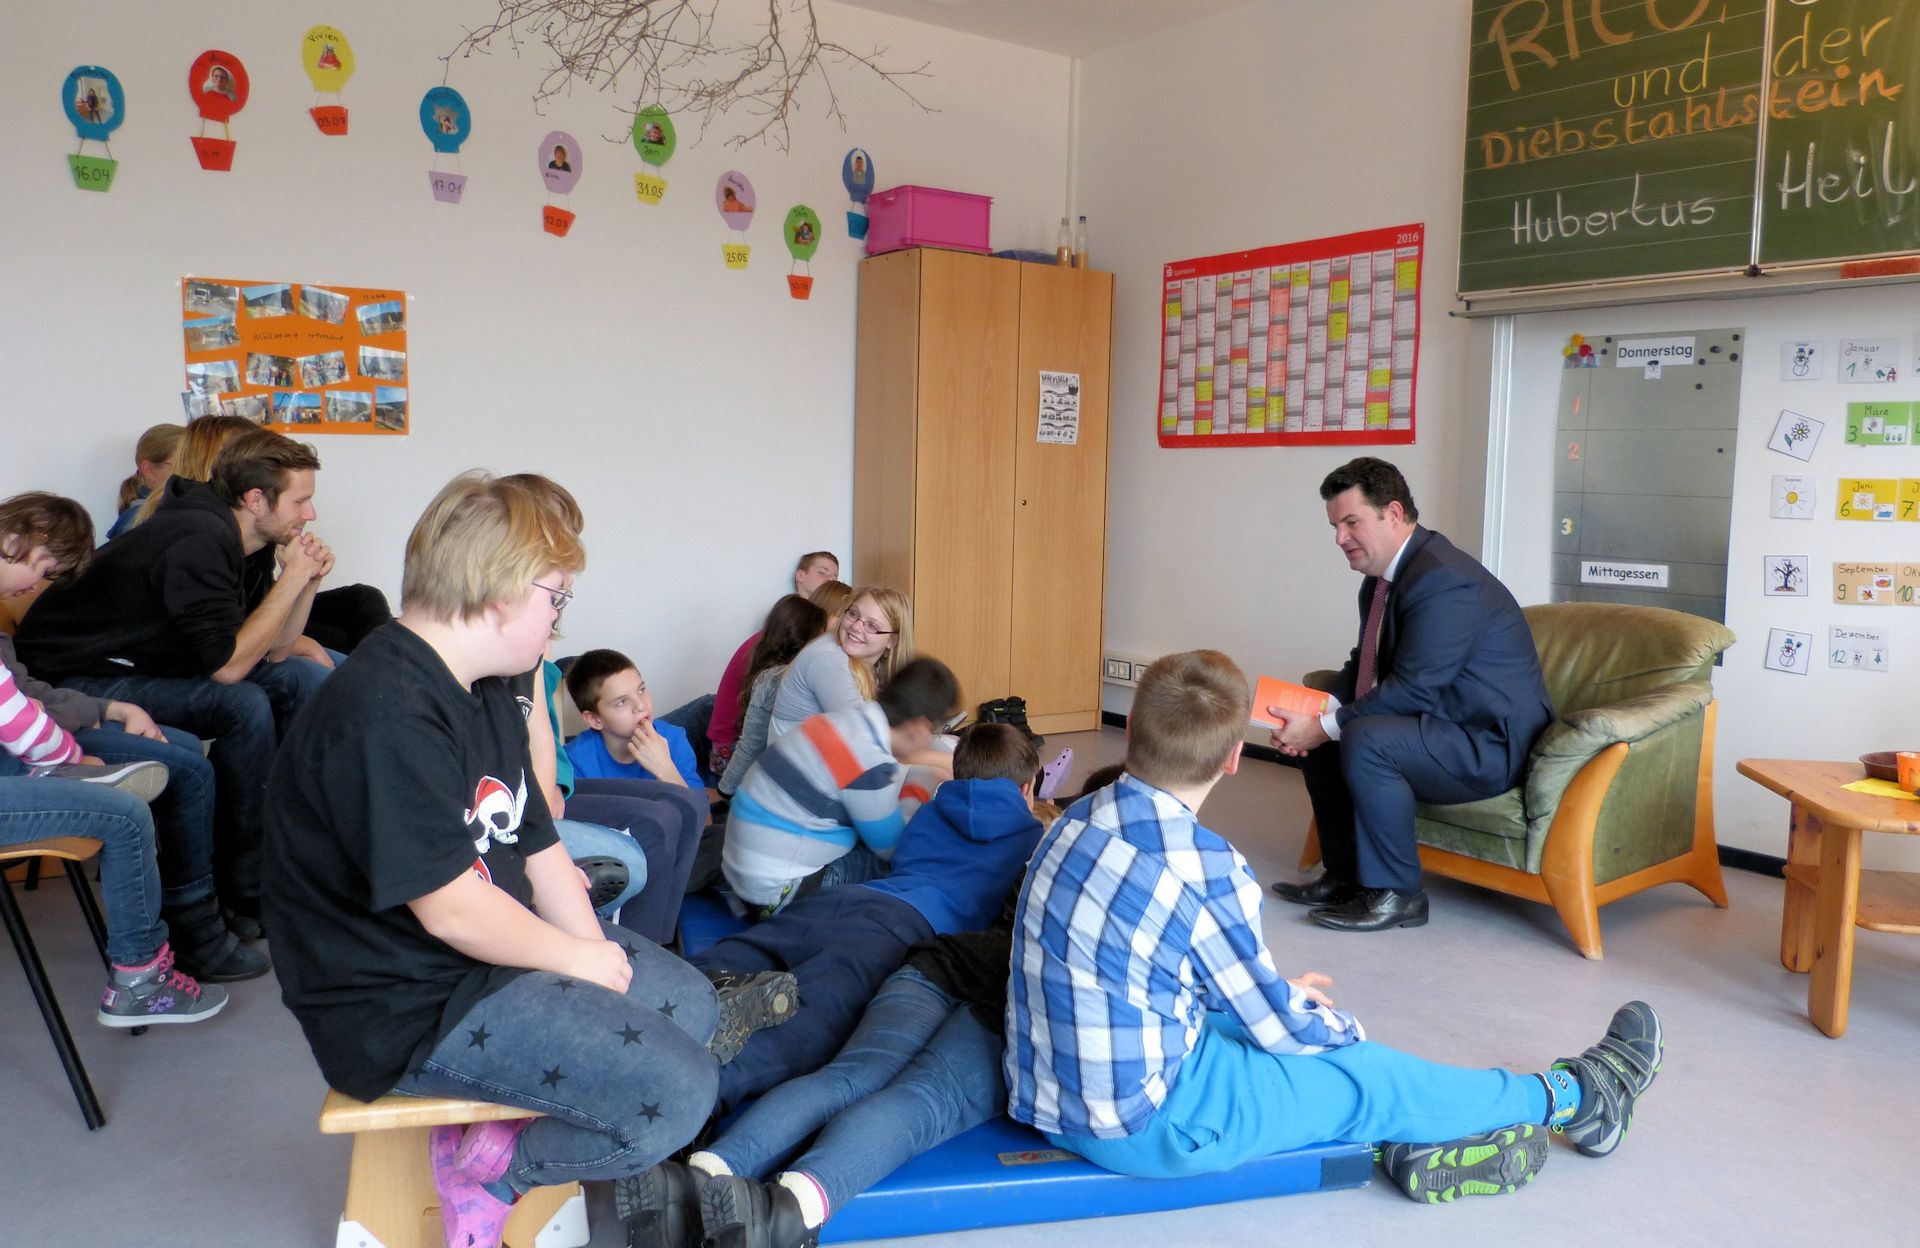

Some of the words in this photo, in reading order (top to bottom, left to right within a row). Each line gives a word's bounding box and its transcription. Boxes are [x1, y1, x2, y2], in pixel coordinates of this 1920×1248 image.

[307, 33, 339, 43] Vivien
[1613, 32, 1711, 109] und
[1772, 11, 1892, 77] der
[1482, 64, 1903, 169] Diebstahlstein
[1510, 172, 1717, 245] Hubertus
[1777, 121, 1917, 210] Heil
[1396, 231, 1419, 245] 2016
[1617, 344, 1693, 358] Donnerstag
[1844, 342, 1881, 357] Januar
[1846, 361, 1856, 377] 1
[1571, 397, 1581, 415] 1
[1847, 424, 1858, 442] 3
[1567, 442, 1580, 461] 2
[1852, 481, 1874, 493] Juni
[1839, 500, 1850, 517] 6
[1902, 500, 1915, 518] 7
[1560, 517, 1574, 536] 3
[1587, 565, 1659, 581] Mittagessen
[1838, 563, 1889, 577] September
[1837, 583, 1847, 600] 9
[1896, 584, 1914, 603] 10
[1834, 628, 1880, 641] Dezember
[1831, 649, 1847, 664] 12
